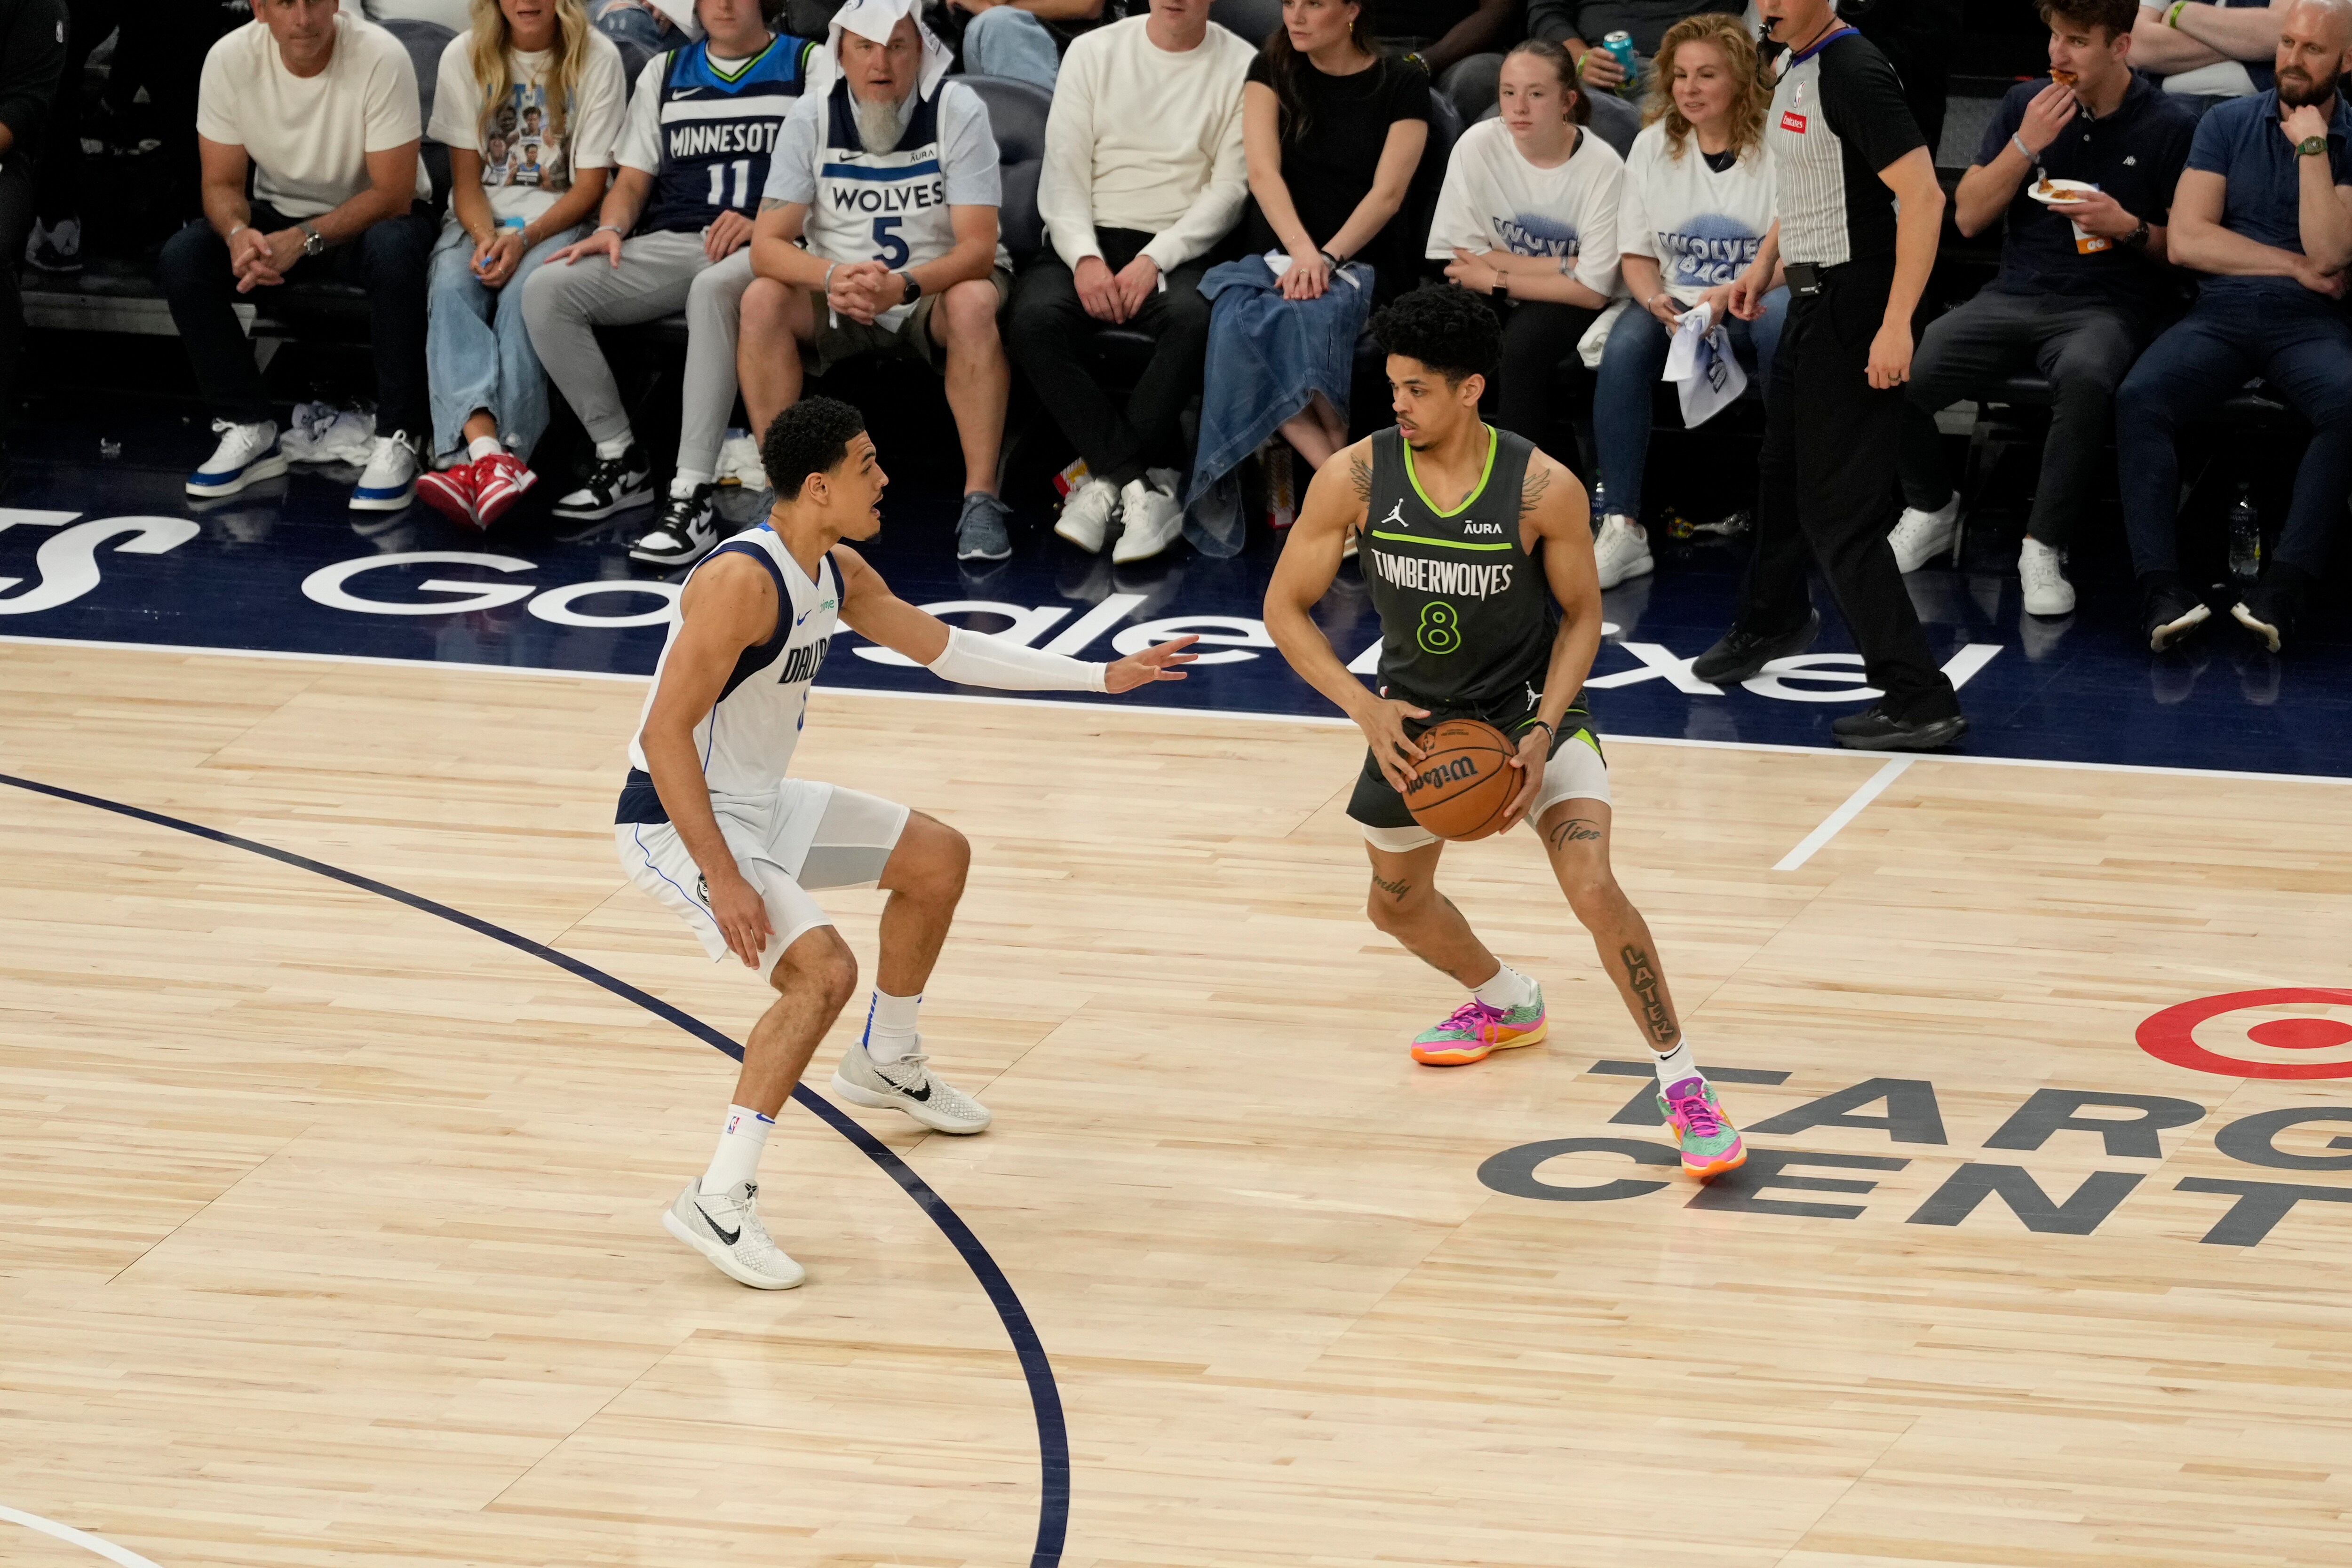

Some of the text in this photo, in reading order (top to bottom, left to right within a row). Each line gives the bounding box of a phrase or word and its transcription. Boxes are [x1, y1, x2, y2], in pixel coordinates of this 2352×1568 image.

[670, 122, 779, 158] MINNESOT
[1782, 115, 1803, 128] Emirates
[707, 159, 750, 208] 11
[832, 181, 943, 213] WOLVES
[872, 217, 909, 269] 5
[1371, 548, 1513, 602] TIMBERWOLVES
[1416, 601, 1462, 655] 8
[776, 633, 834, 685] DALLA
[1406, 755, 1478, 796] Wilson
[1549, 818, 1602, 851] Ties
[1625, 948, 1674, 1042] LATER
